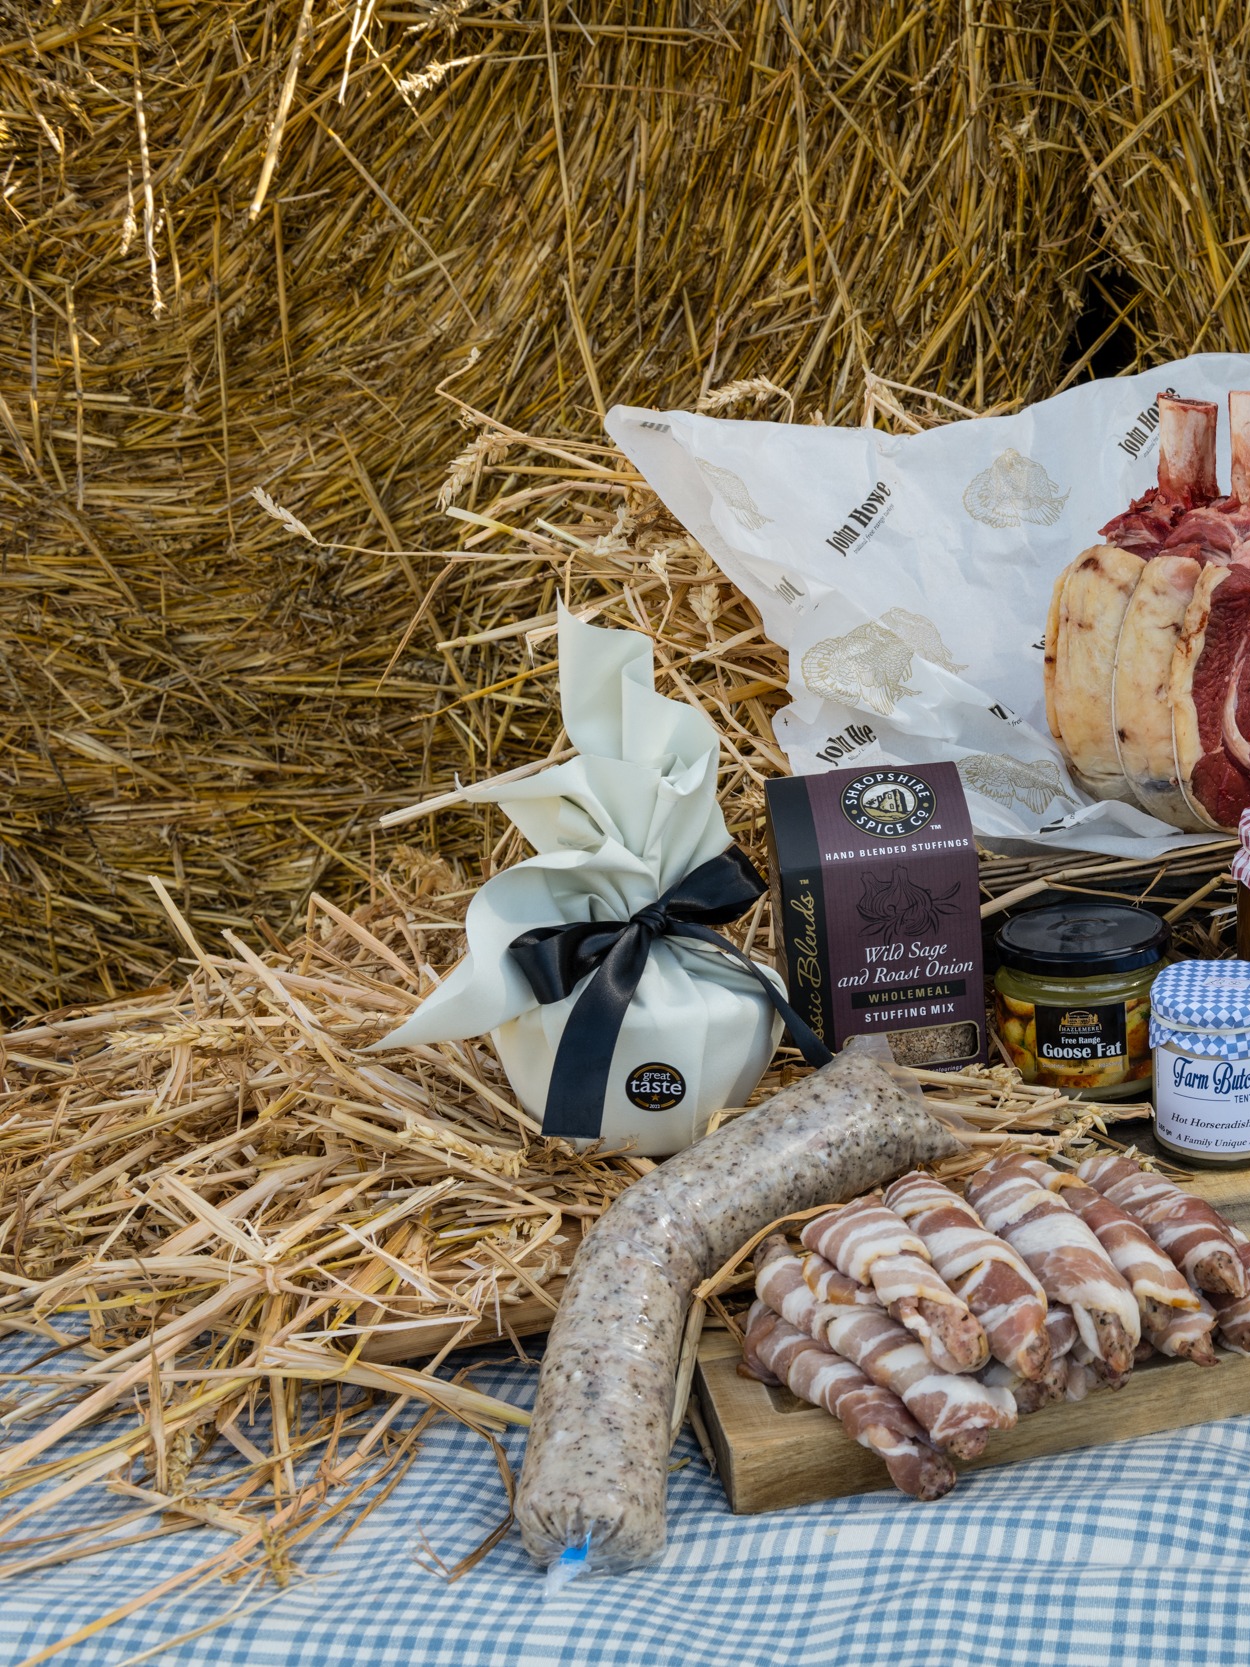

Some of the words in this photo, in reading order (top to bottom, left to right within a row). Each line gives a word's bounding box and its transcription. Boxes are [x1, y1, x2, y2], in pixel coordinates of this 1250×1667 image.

[1117, 426, 1149, 461] John
[825, 524, 860, 557] John
[847, 481, 892, 529] Howe
[845, 773, 930, 805] SHROPSHIRE
[856, 816, 905, 835] SPICE
[825, 850, 855, 861] HAND
[859, 845, 907, 858] BLENDED
[911, 838, 969, 852] STUFFINGS
[790, 890, 822, 988] Blends
[865, 942, 904, 964] Wild
[908, 941, 948, 960] Sage
[837, 967, 869, 988] and
[873, 965, 921, 984] Roast
[925, 958, 973, 978] Onion
[868, 985, 950, 1003] WHOLEMEAL
[865, 1006, 927, 1023] STUFFING
[930, 1003, 955, 1014] MIX
[1042, 1043, 1092, 1059] Goose
[1097, 1041, 1122, 1057] Fat
[1078, 1036, 1101, 1045] Range
[643, 1072, 671, 1081] great
[1173, 1056, 1209, 1090] Farm
[630, 1079, 682, 1095] taste
[1171, 1112, 1188, 1125] Hot
[1176, 1133, 1182, 1141] A
[1184, 1135, 1213, 1148] Family
[1214, 1139, 1247, 1149] Unique
